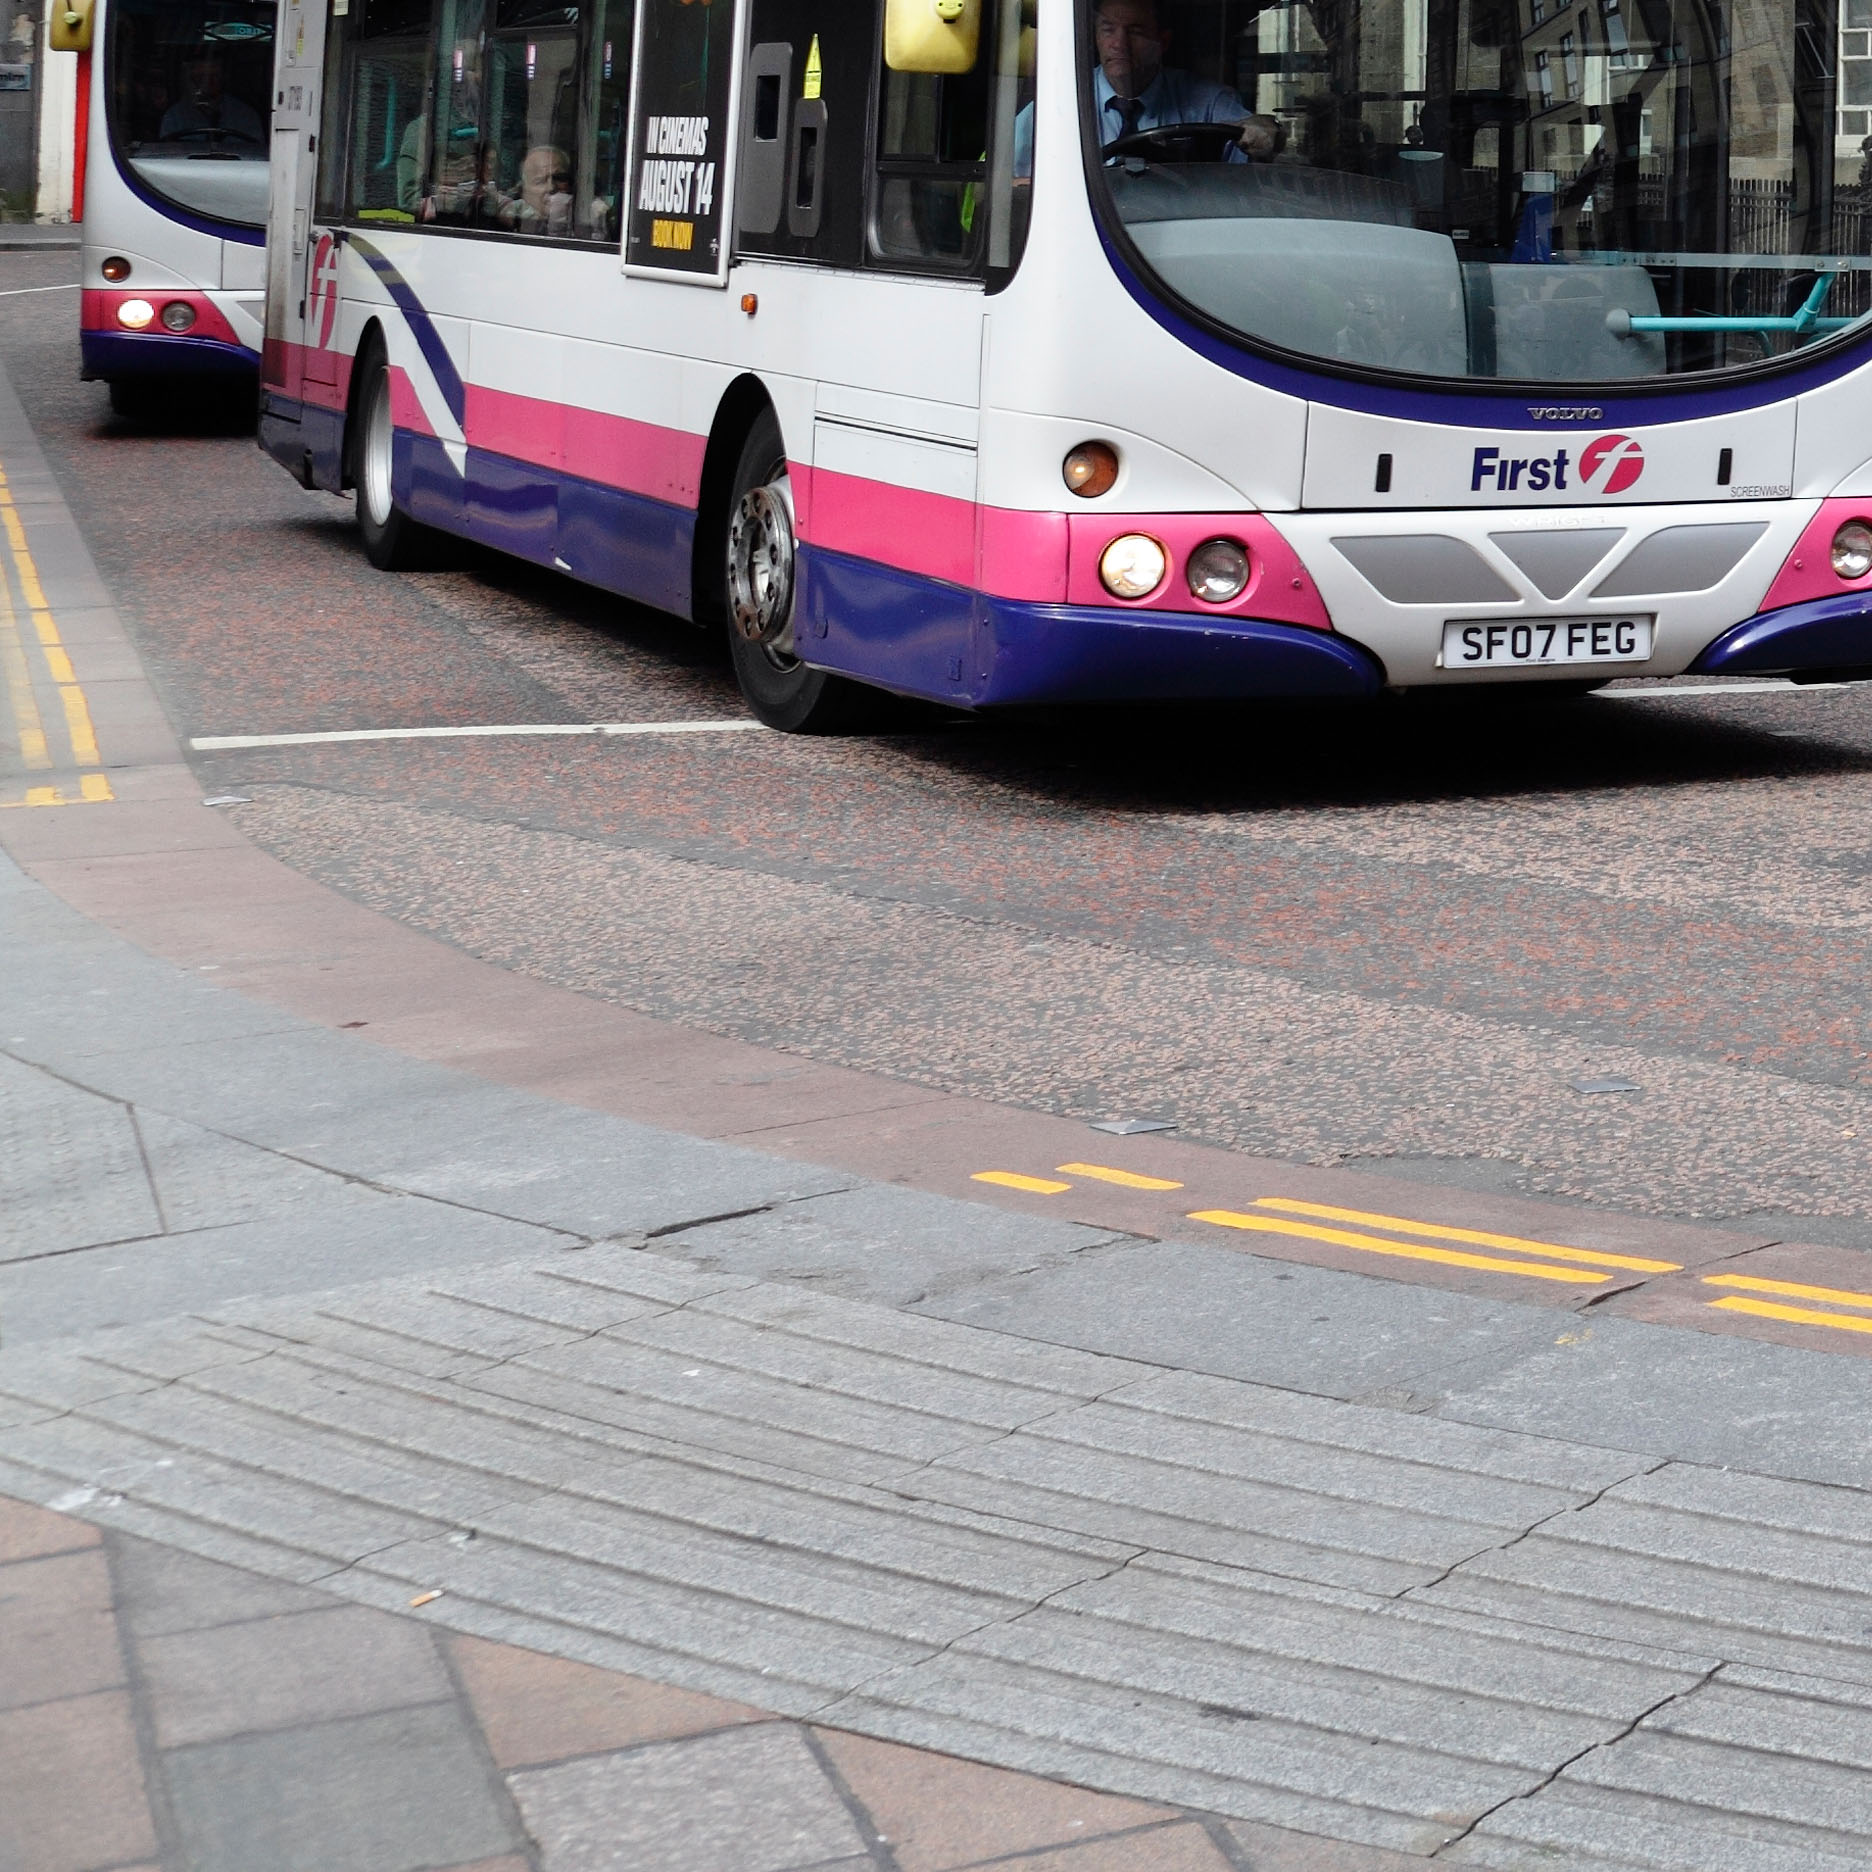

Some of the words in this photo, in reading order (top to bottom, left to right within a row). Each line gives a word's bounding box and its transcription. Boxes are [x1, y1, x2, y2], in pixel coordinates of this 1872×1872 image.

[647, 116, 660, 154] IN
[659, 116, 709, 156] CINEMAS
[638, 160, 695, 214] AUGUST
[695, 162, 715, 215] 14
[1527, 407, 1603, 420] VOLVO
[1471, 447, 1570, 491] First
[1730, 485, 1791, 497] SCREENWASH
[1462, 624, 1556, 661] SF07
[1568, 621, 1636, 656] FEG
